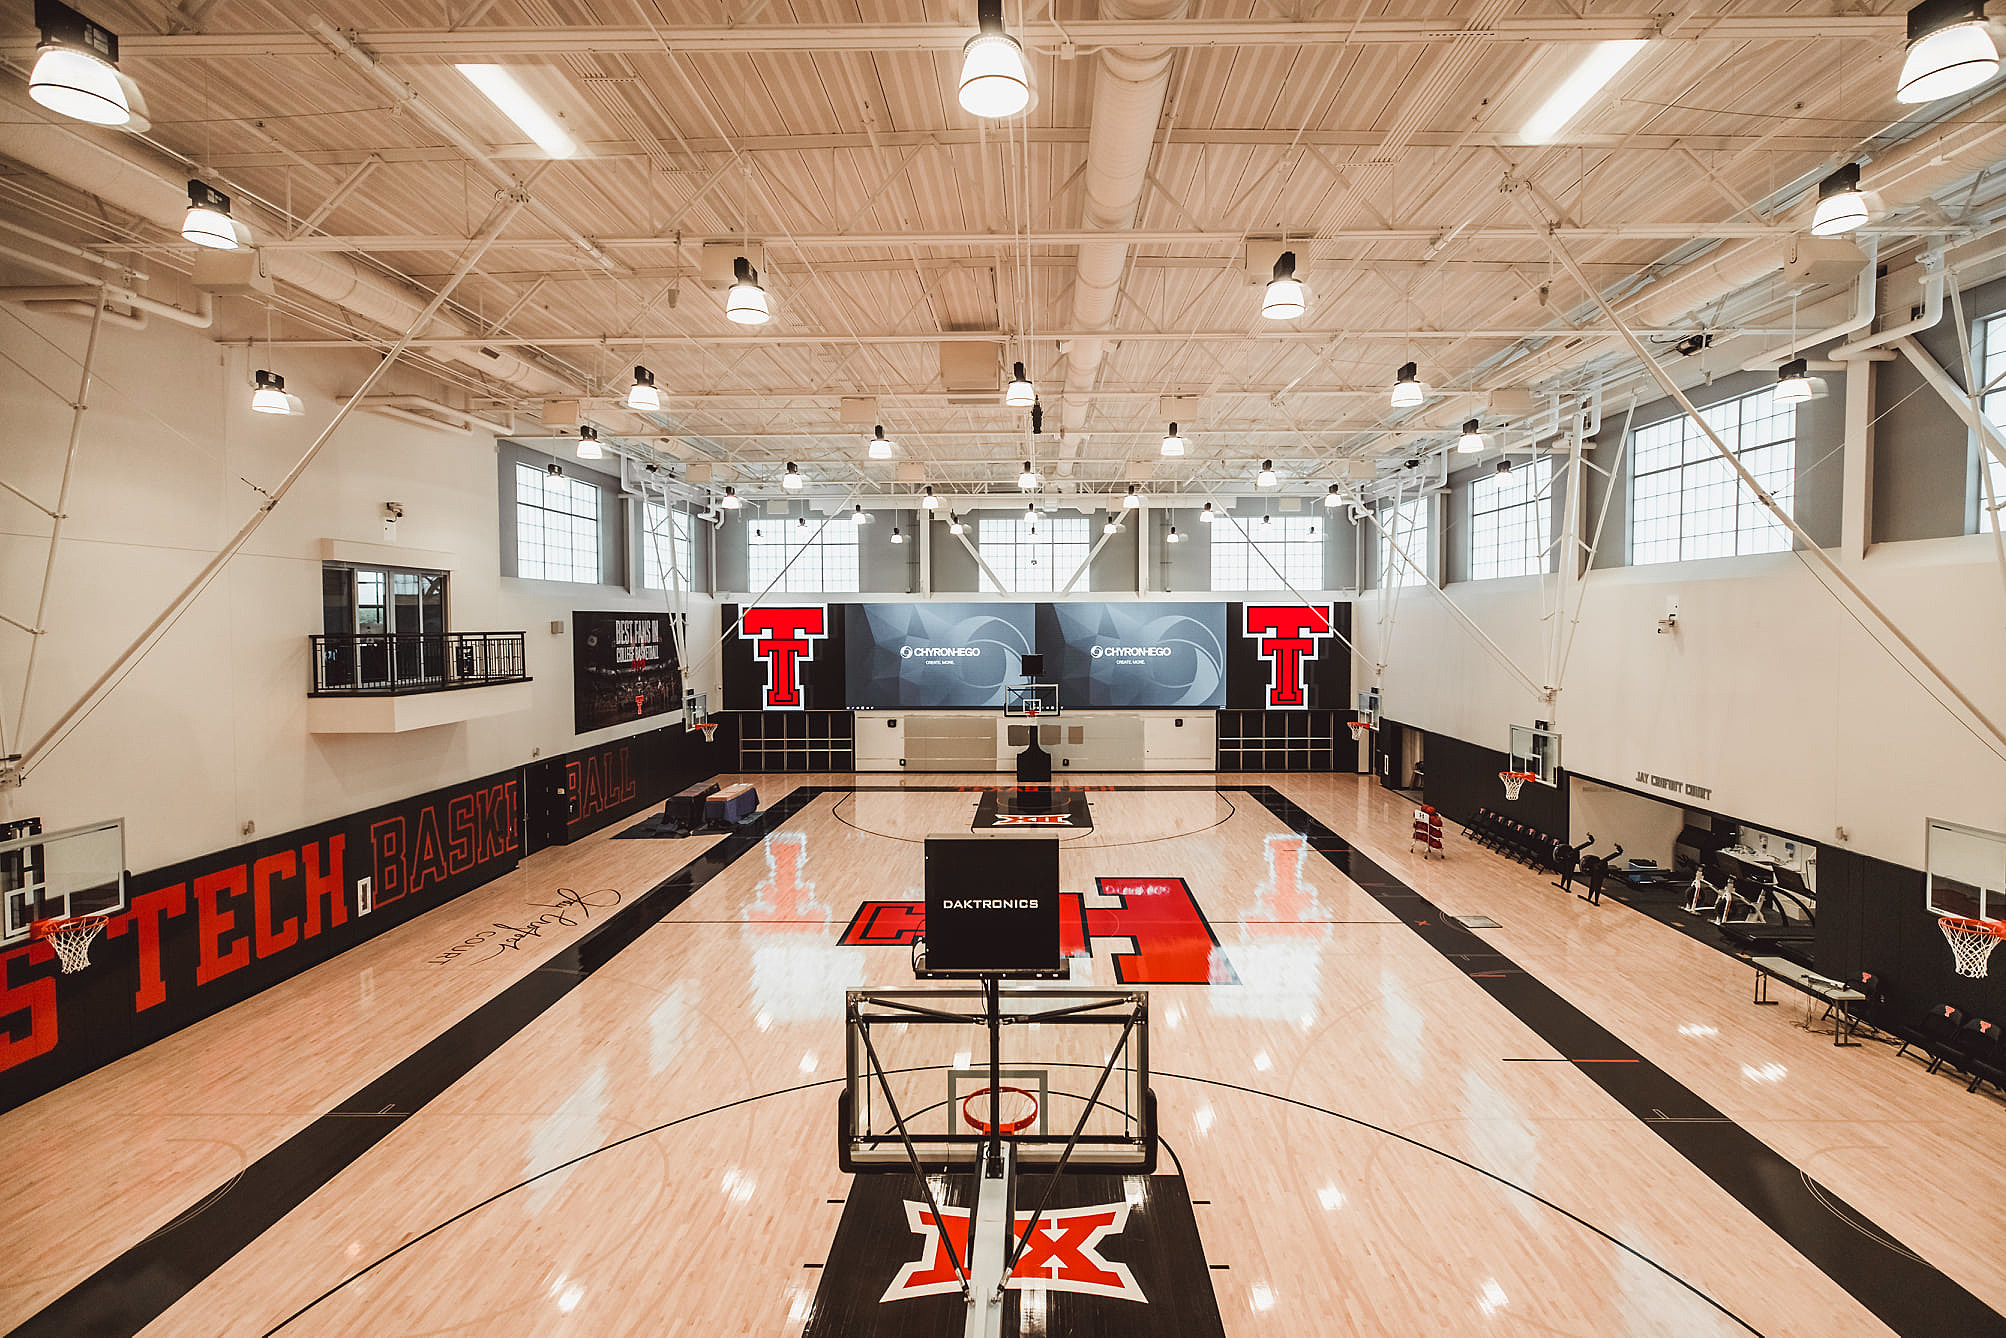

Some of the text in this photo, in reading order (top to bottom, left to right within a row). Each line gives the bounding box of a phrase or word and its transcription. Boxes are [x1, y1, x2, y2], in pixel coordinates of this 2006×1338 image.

[616, 620, 633, 644] BEST
[634, 620, 651, 644] FANS
[1636, 772, 1649, 784] JAY
[1685, 784, 1712, 800] COURT
[943, 899, 1039, 909] DAKTRONICS
[107, 833, 349, 1014] TECH
[428, 931, 497, 966] COURT
